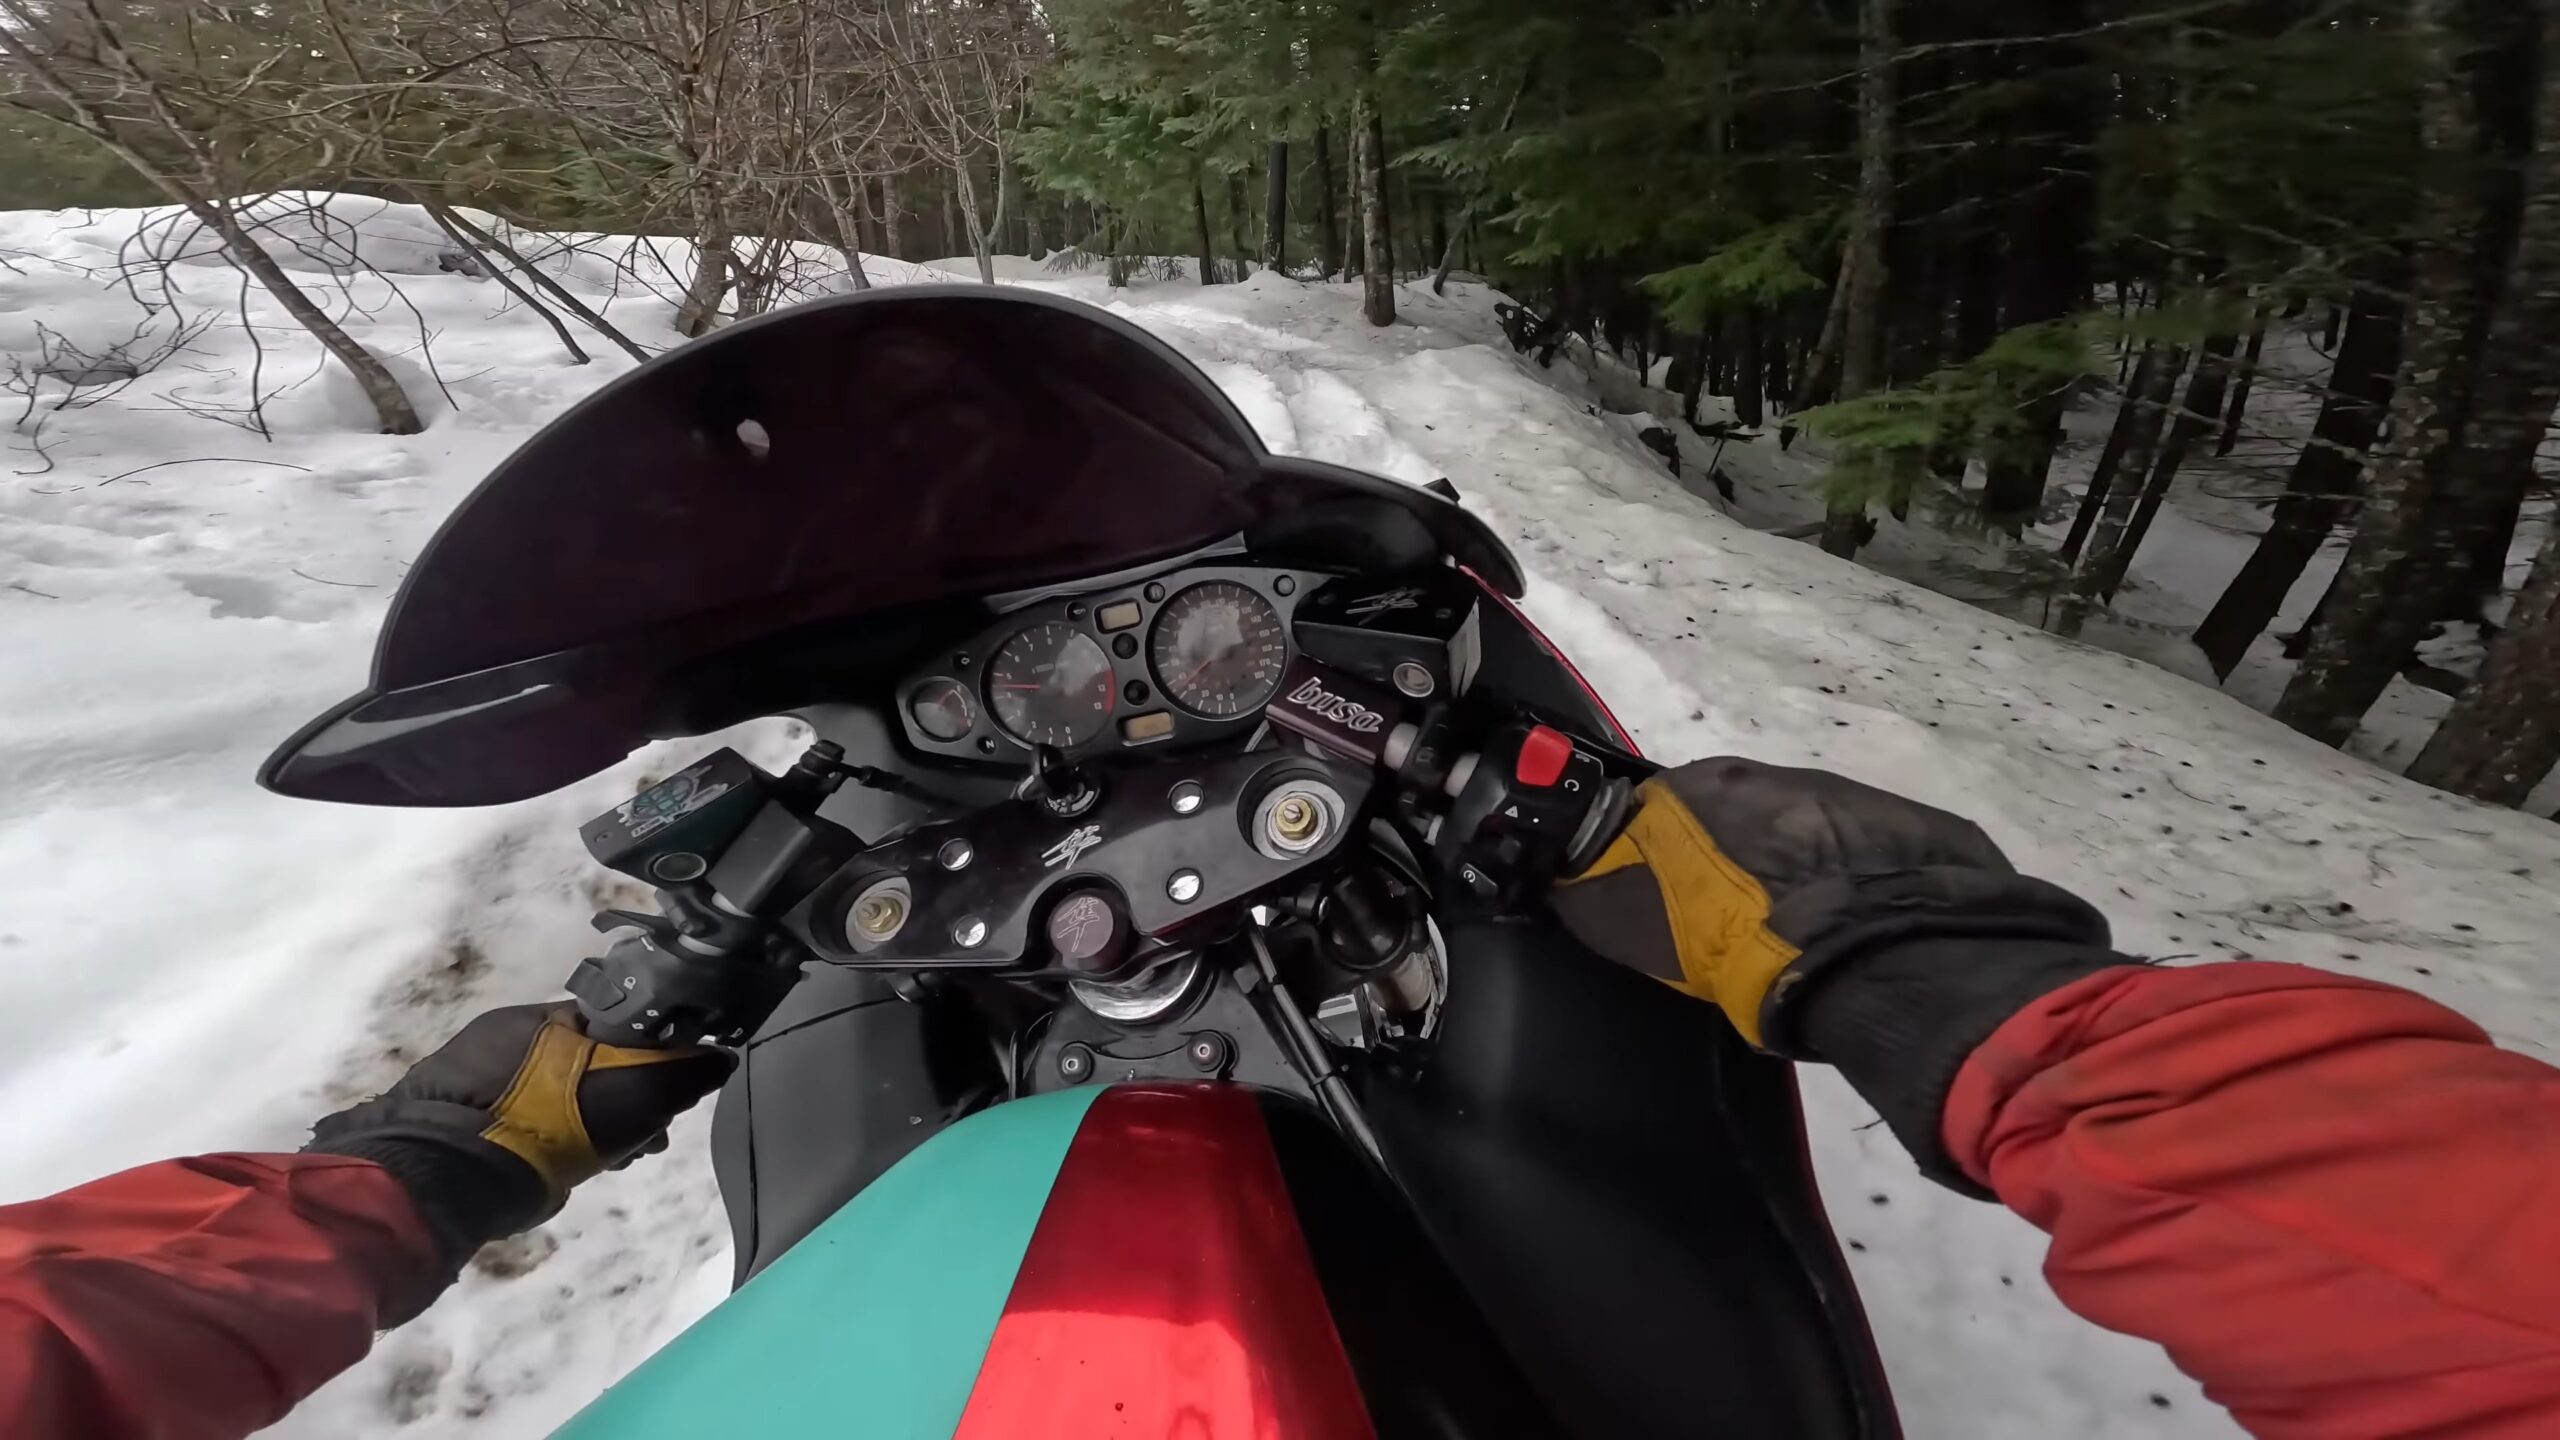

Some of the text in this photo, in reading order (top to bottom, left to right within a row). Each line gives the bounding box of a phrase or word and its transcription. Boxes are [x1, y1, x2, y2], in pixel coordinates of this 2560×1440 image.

[1028, 643, 1034, 652] 7
[1285, 675, 1385, 733] busa
[1031, 721, 1038, 729] 2
[1064, 725, 1071, 735] 0
[985, 739, 995, 749] N
